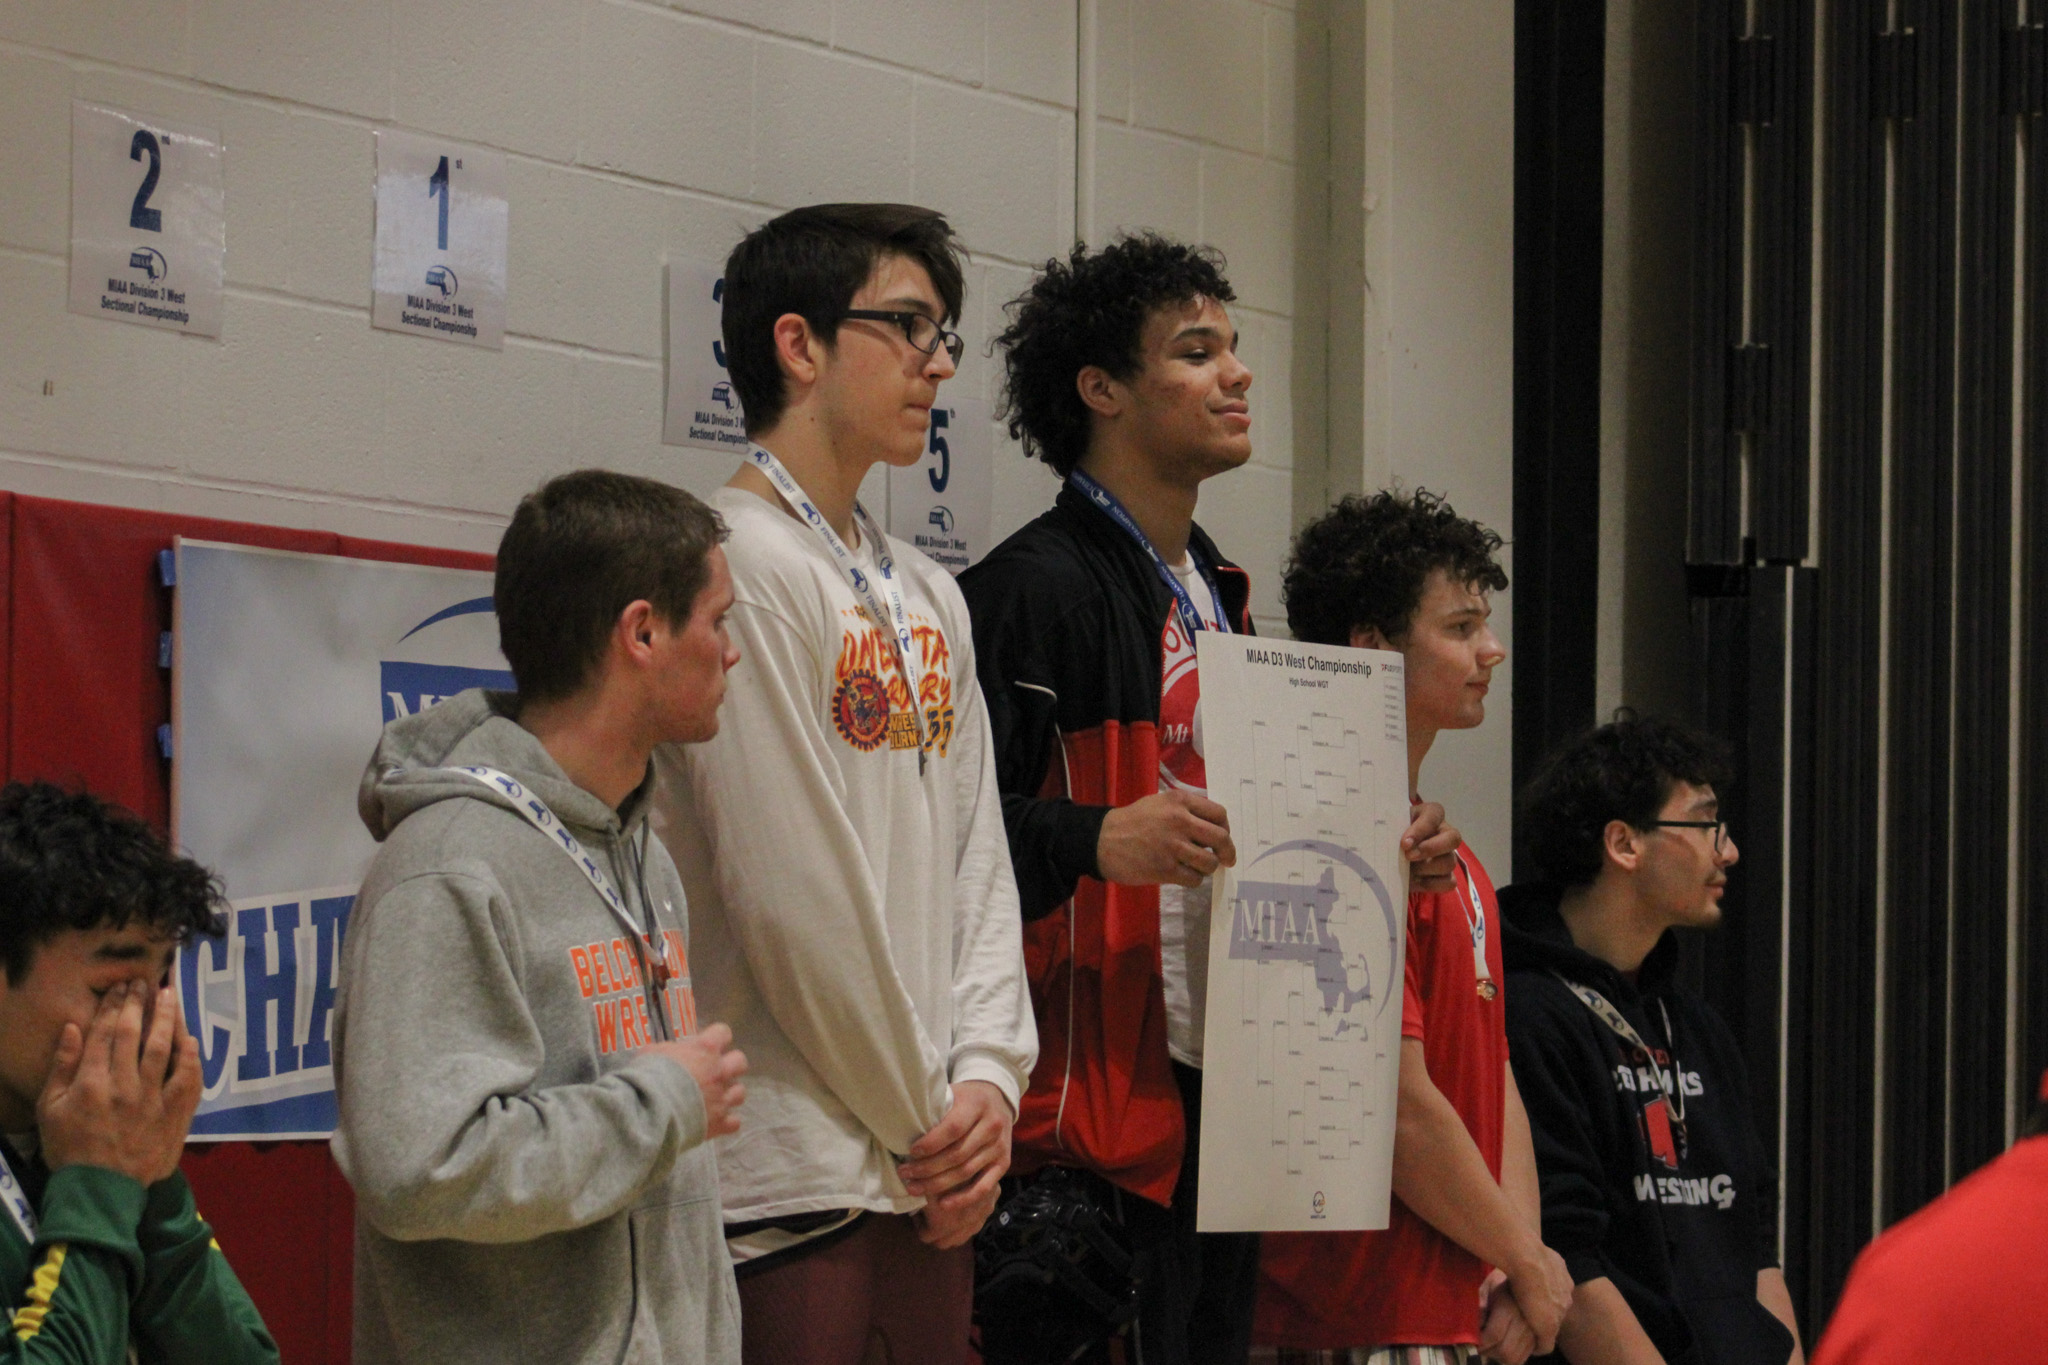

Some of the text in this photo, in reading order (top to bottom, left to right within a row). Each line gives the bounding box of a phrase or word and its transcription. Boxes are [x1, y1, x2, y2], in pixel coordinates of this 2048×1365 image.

[108, 278, 186, 304] MIAA Division 3 West
[101, 295, 189, 325] Sectional Championship
[407, 295, 474, 319] MIAA Division 3 West
[402, 310, 477, 339] Sectional Championship
[695, 411, 710, 424] MIAA
[711, 413, 734, 428] Division
[735, 416, 739, 428] 3
[689, 427, 748, 446] Sectional Champions
[769, 464, 796, 493] FINALIST
[1112, 506, 1143, 540] CHAMPION
[820, 527, 846, 557] FINALIST
[915, 534, 967, 551] MIAA Division 3 West
[935, 552, 969, 568] Championship
[866, 595, 888, 627] FINALIST
[891, 591, 904, 625] FINALIST
[1246, 649, 1270, 665] MIAA
[1271, 651, 1283, 667] D3
[1284, 653, 1306, 670] West
[1307, 656, 1372, 679] Championship
[1289, 677, 1300, 688] High
[1300, 678, 1317, 689] School
[1239, 899, 1321, 945] MIAA
